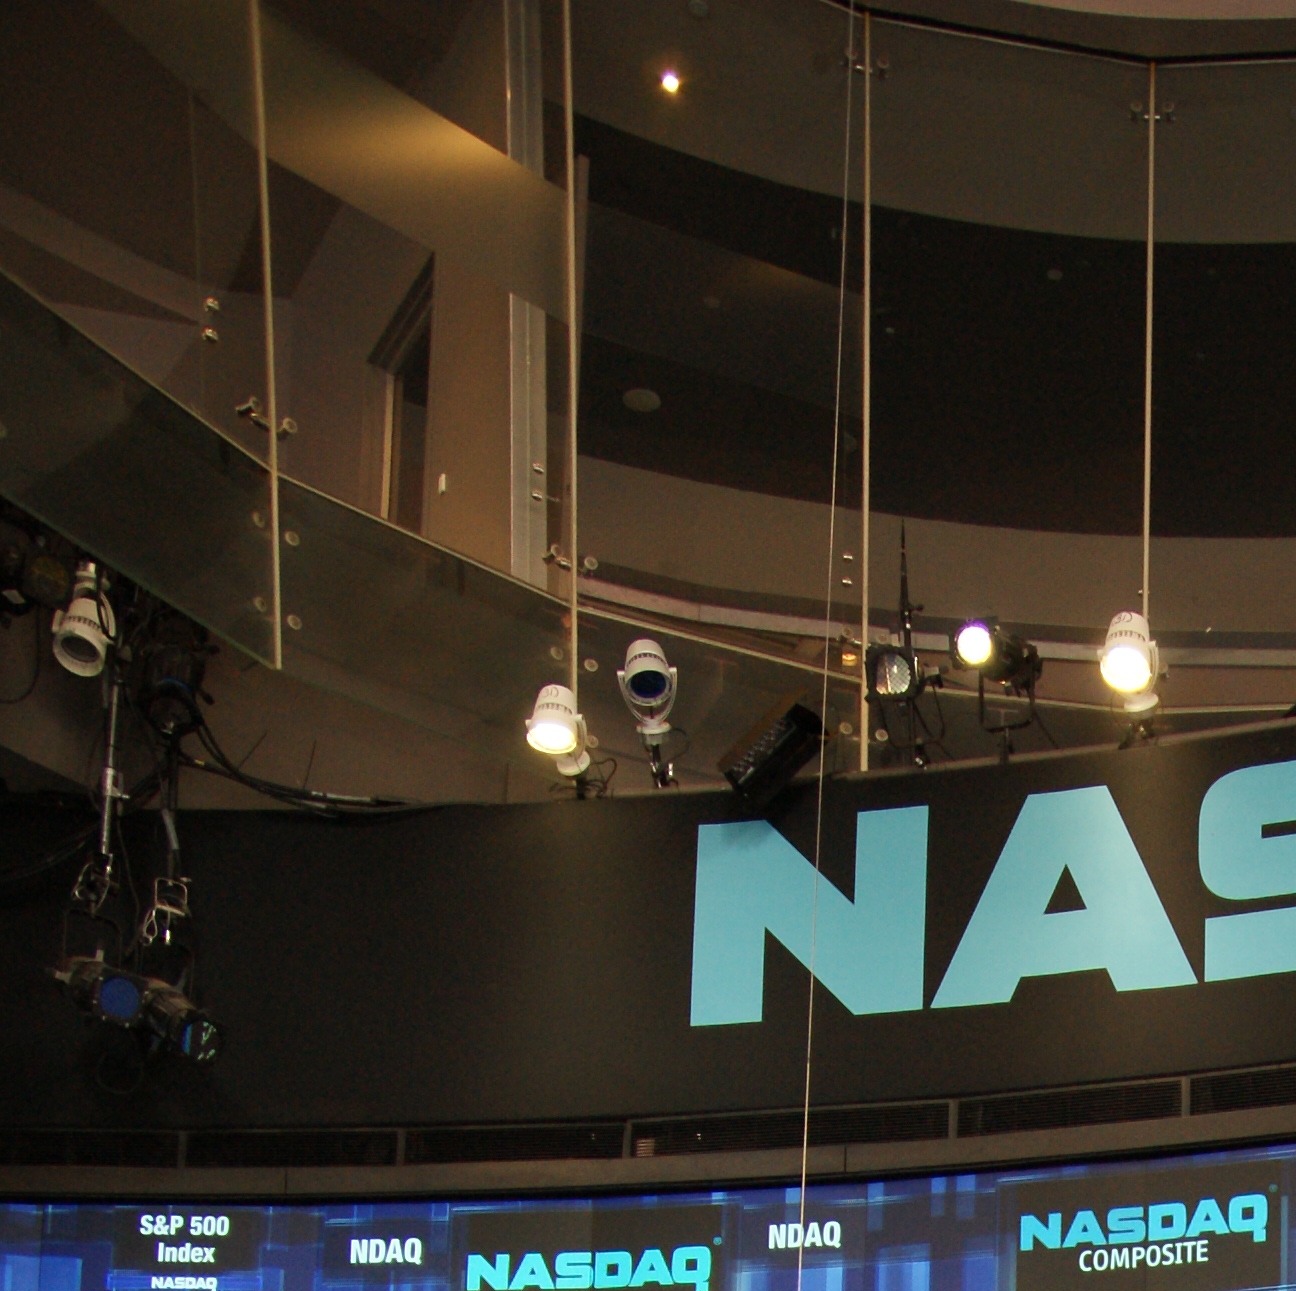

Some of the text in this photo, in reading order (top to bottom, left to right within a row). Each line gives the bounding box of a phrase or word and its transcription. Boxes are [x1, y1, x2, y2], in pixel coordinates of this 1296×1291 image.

[140, 1214, 230, 1236] S&P 500
[768, 1221, 842, 1249] NDAQ
[1020, 1194, 1268, 1251] NASDAQ
[157, 1241, 215, 1264] Index
[350, 1237, 423, 1266] NDAQ
[1079, 1240, 1209, 1272] COMPOSITE
